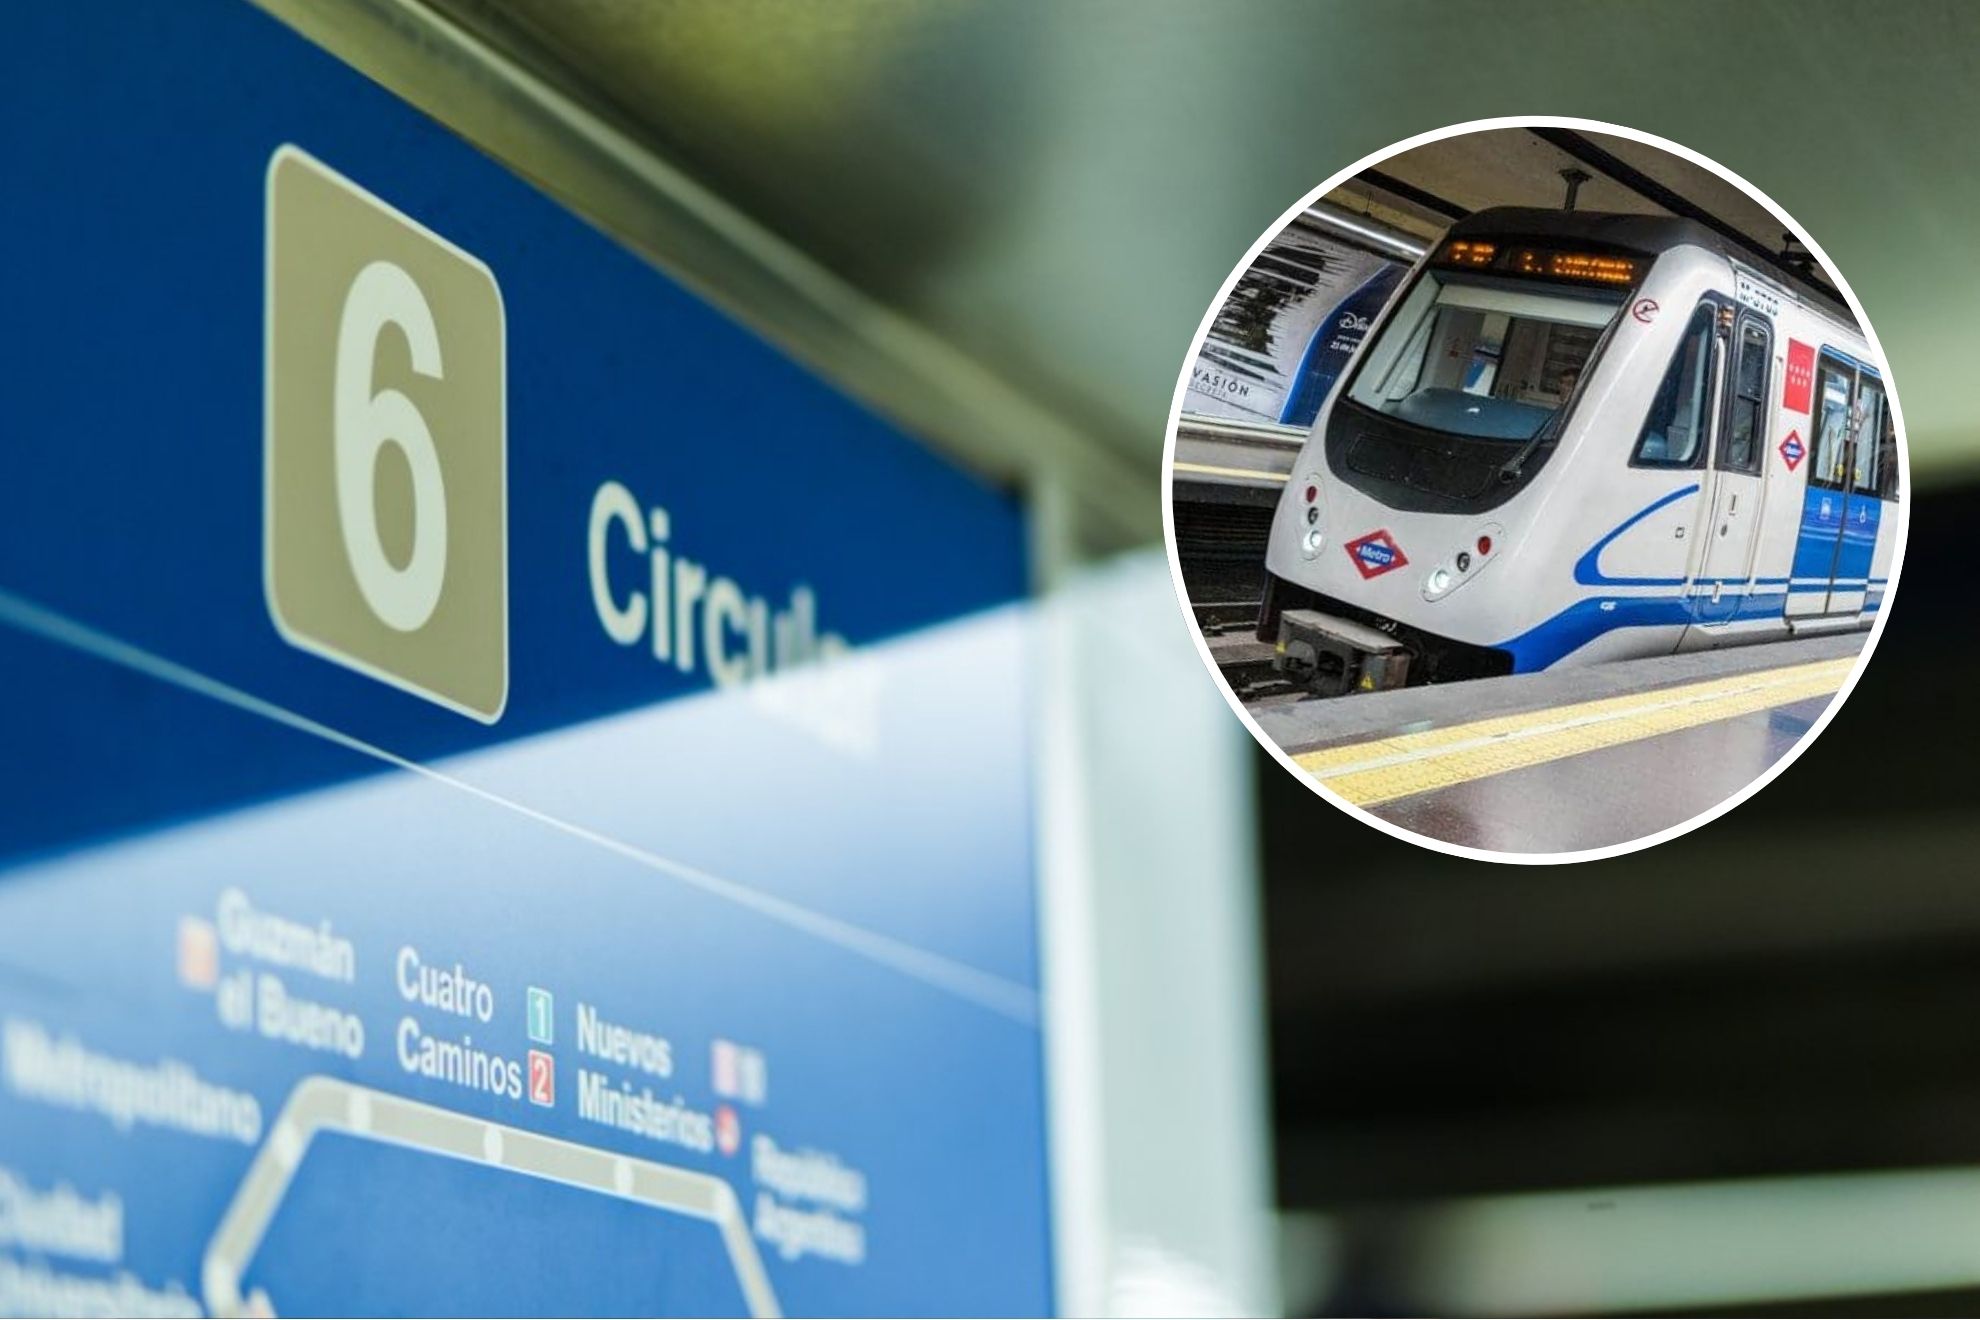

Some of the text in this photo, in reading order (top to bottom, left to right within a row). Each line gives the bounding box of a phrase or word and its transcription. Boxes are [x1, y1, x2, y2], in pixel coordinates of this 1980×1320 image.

[334, 261, 448, 632] 6
[1360, 545, 1392, 564] Metro
[588, 479, 878, 755] Circul
[216, 886, 355, 985] Guzmán
[257, 973, 365, 1060] Bueno
[397, 945, 493, 1022] Cuatro
[397, 1016, 522, 1100] Caminos
[577, 1001, 673, 1079] Nuevos
[577, 1068, 715, 1154] Ministerios
